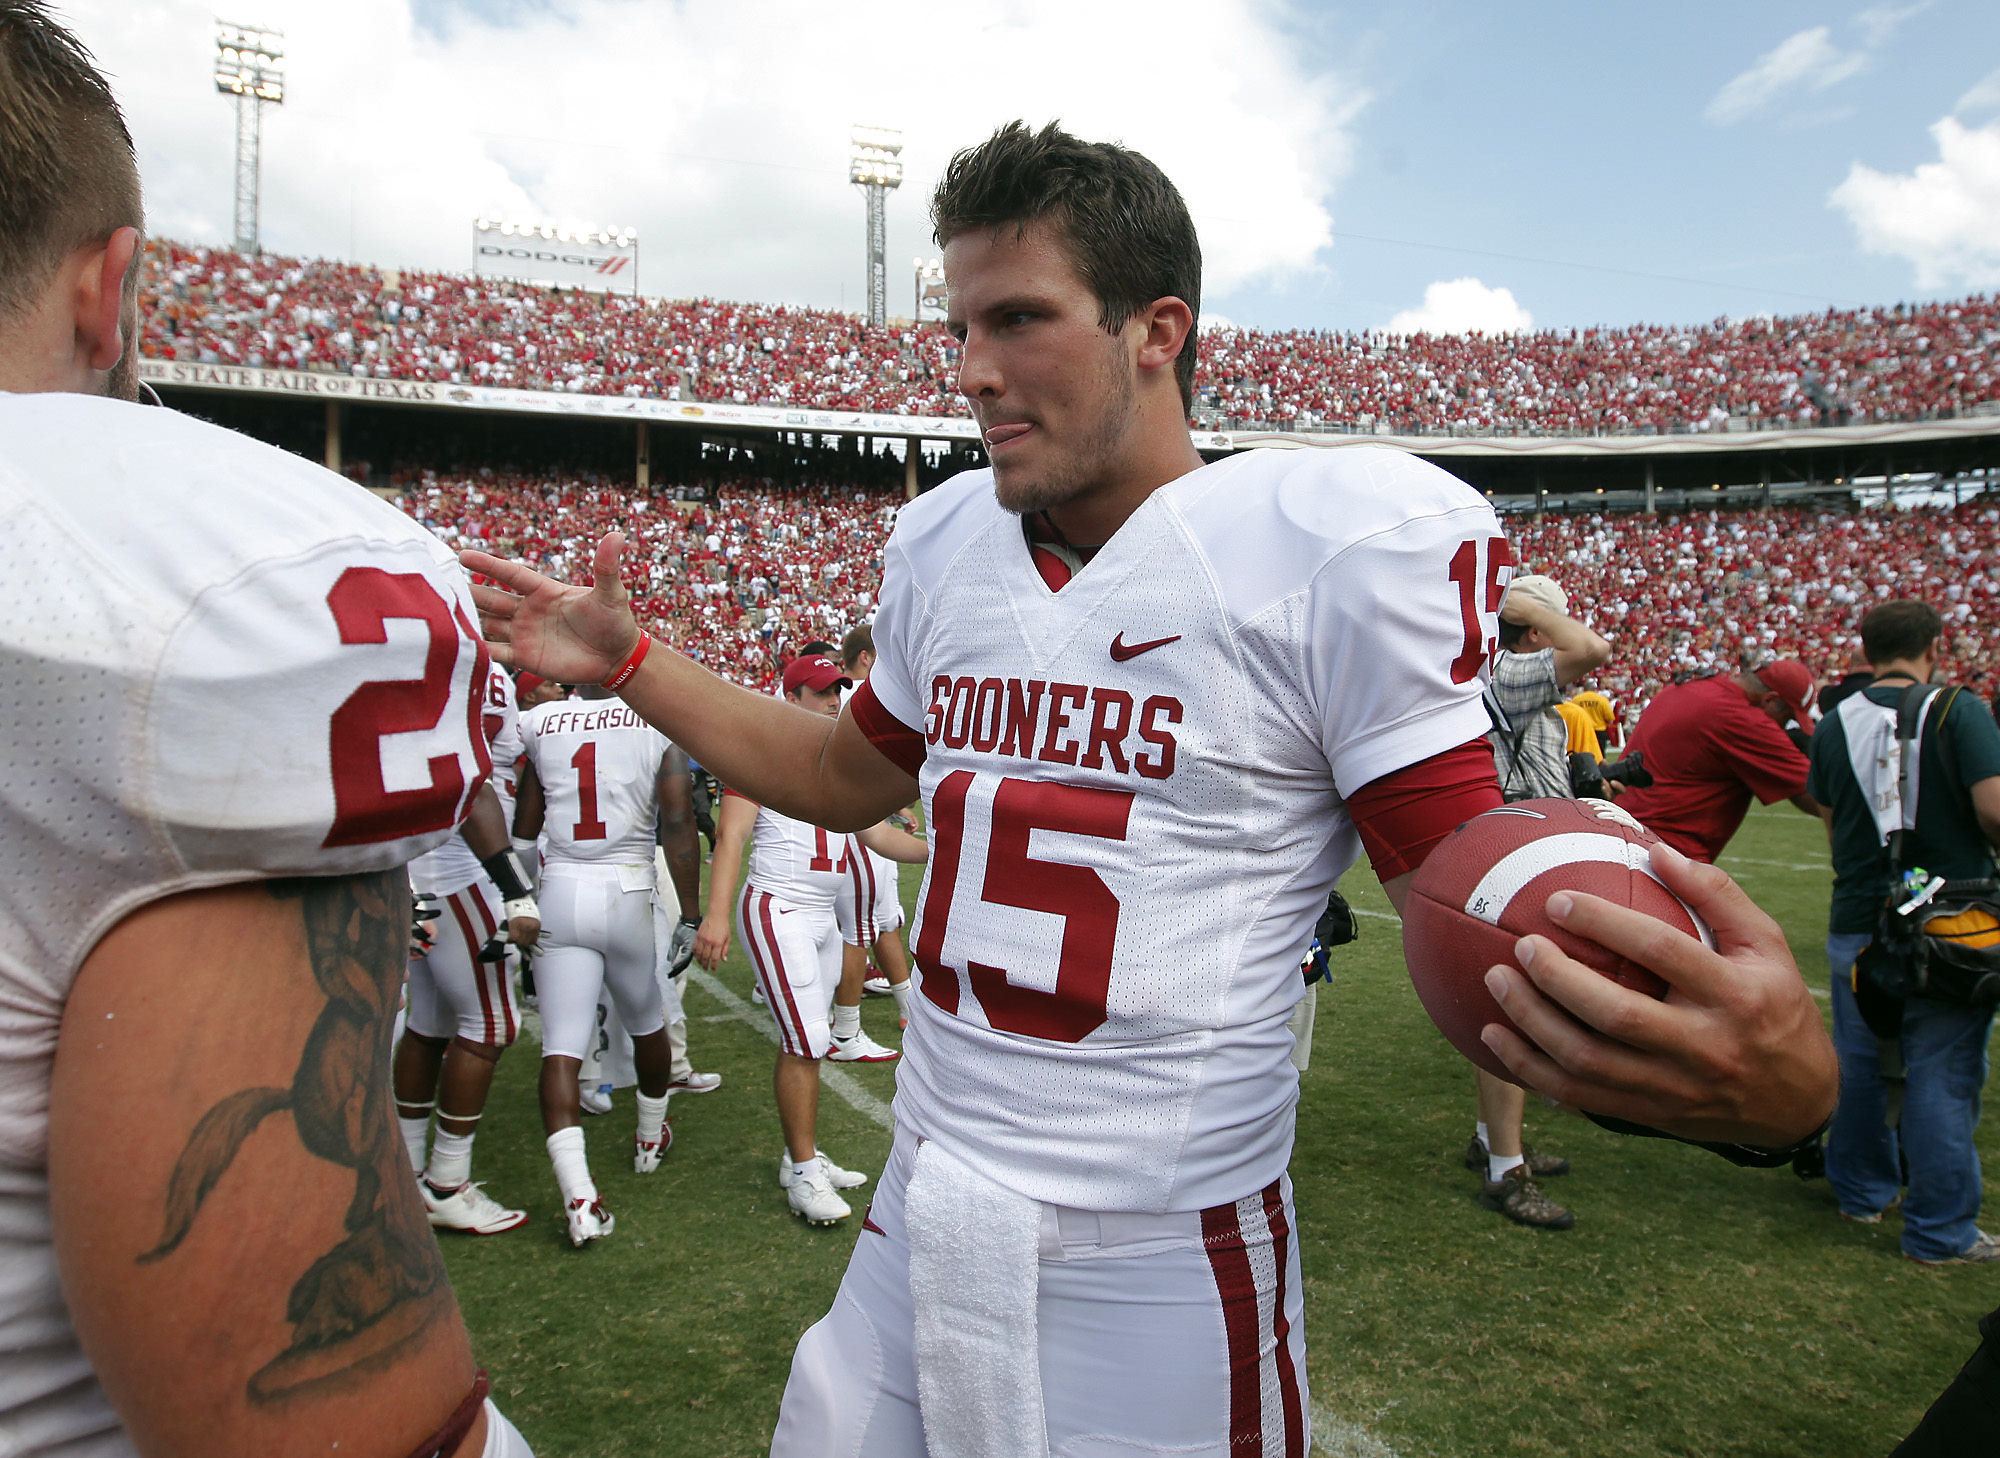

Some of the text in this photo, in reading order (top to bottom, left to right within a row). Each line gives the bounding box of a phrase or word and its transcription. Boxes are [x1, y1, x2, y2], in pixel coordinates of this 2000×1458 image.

[480, 246, 608, 266] DODGE
[873, 275, 884, 326] SOUTHWES
[139, 363, 164, 378] HE
[174, 363, 252, 386] STATE
[263, 371, 319, 392] FAIR
[325, 380, 350, 392] OF
[356, 380, 435, 399] TEXAS
[925, 674, 1184, 780] SOONERS
[571, 741, 607, 841] 1
[910, 769, 1136, 1043] 15
